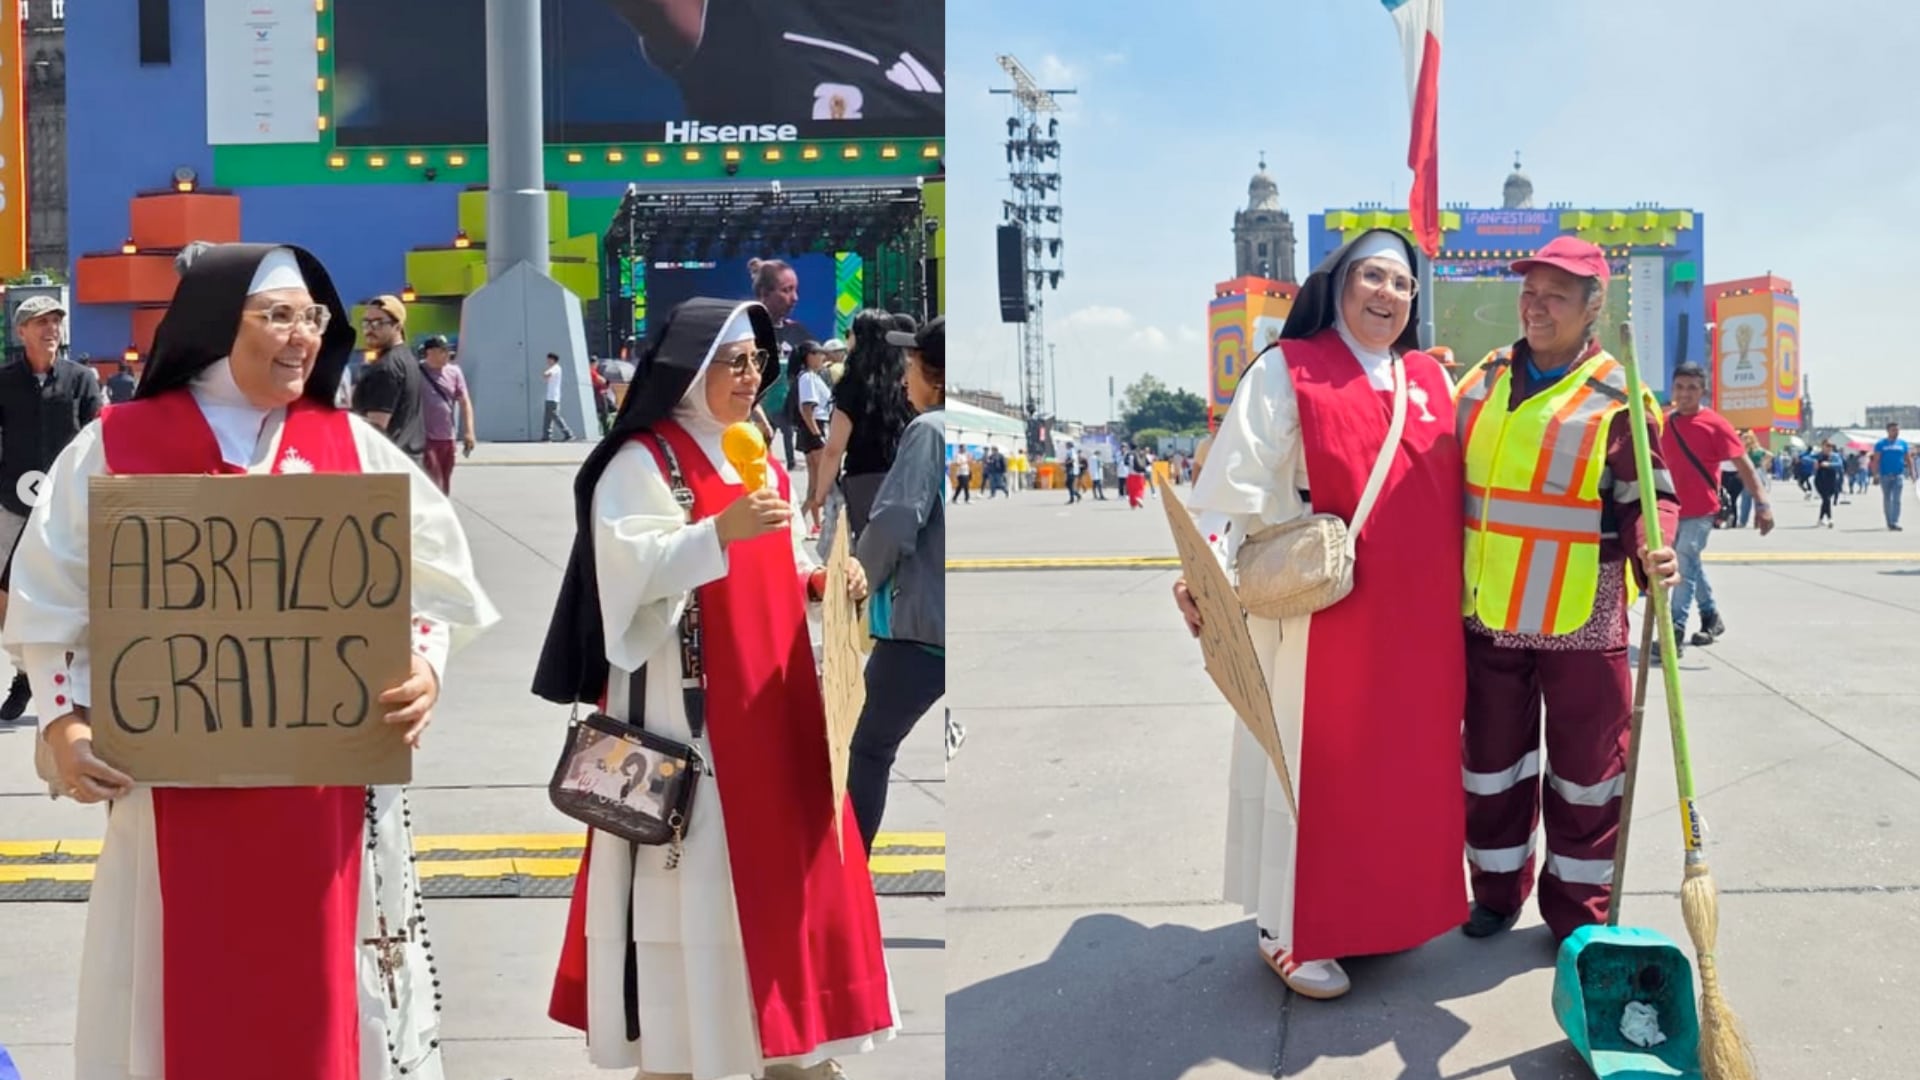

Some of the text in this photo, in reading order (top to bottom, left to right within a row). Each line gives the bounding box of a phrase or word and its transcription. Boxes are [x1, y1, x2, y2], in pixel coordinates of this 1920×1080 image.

[665, 120, 798, 144] Hisense
[1734, 373, 1755, 381] FIFA
[108, 512, 403, 612] ABRAZOS
[110, 634, 370, 734] GRATIS
